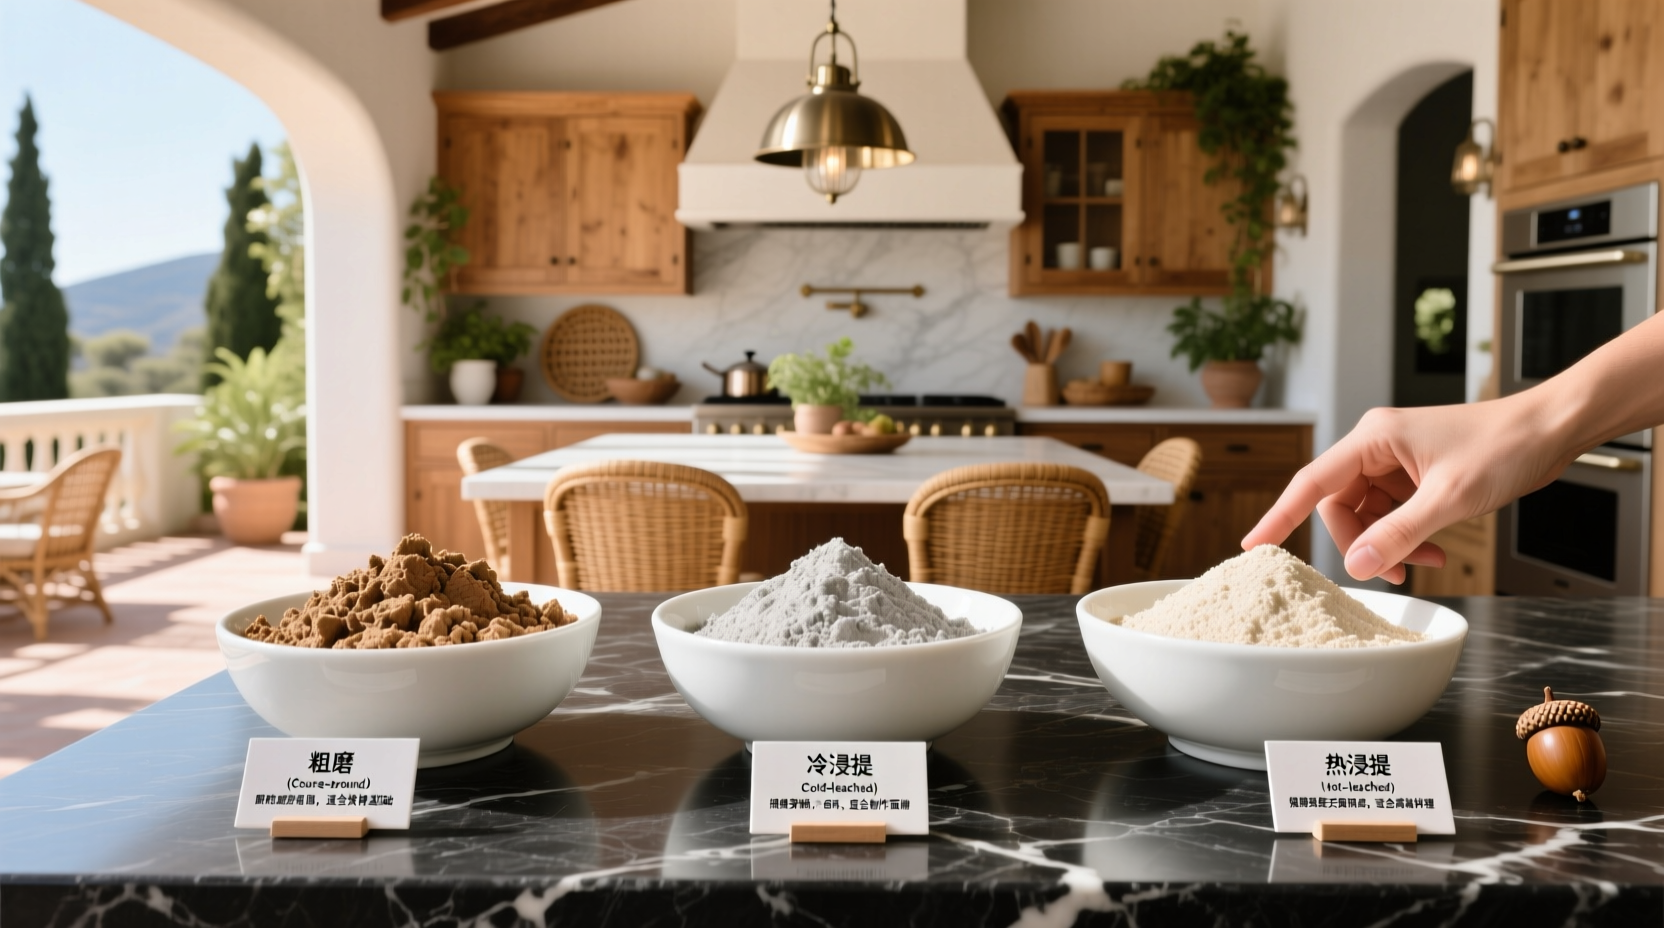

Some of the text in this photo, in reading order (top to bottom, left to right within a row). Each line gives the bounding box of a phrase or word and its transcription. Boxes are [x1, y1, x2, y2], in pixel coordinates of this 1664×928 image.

[307, 750, 356, 775] 粗磨
[806, 753, 874, 777] 冷浸提
[1325, 752, 1392, 777] 热浸提
